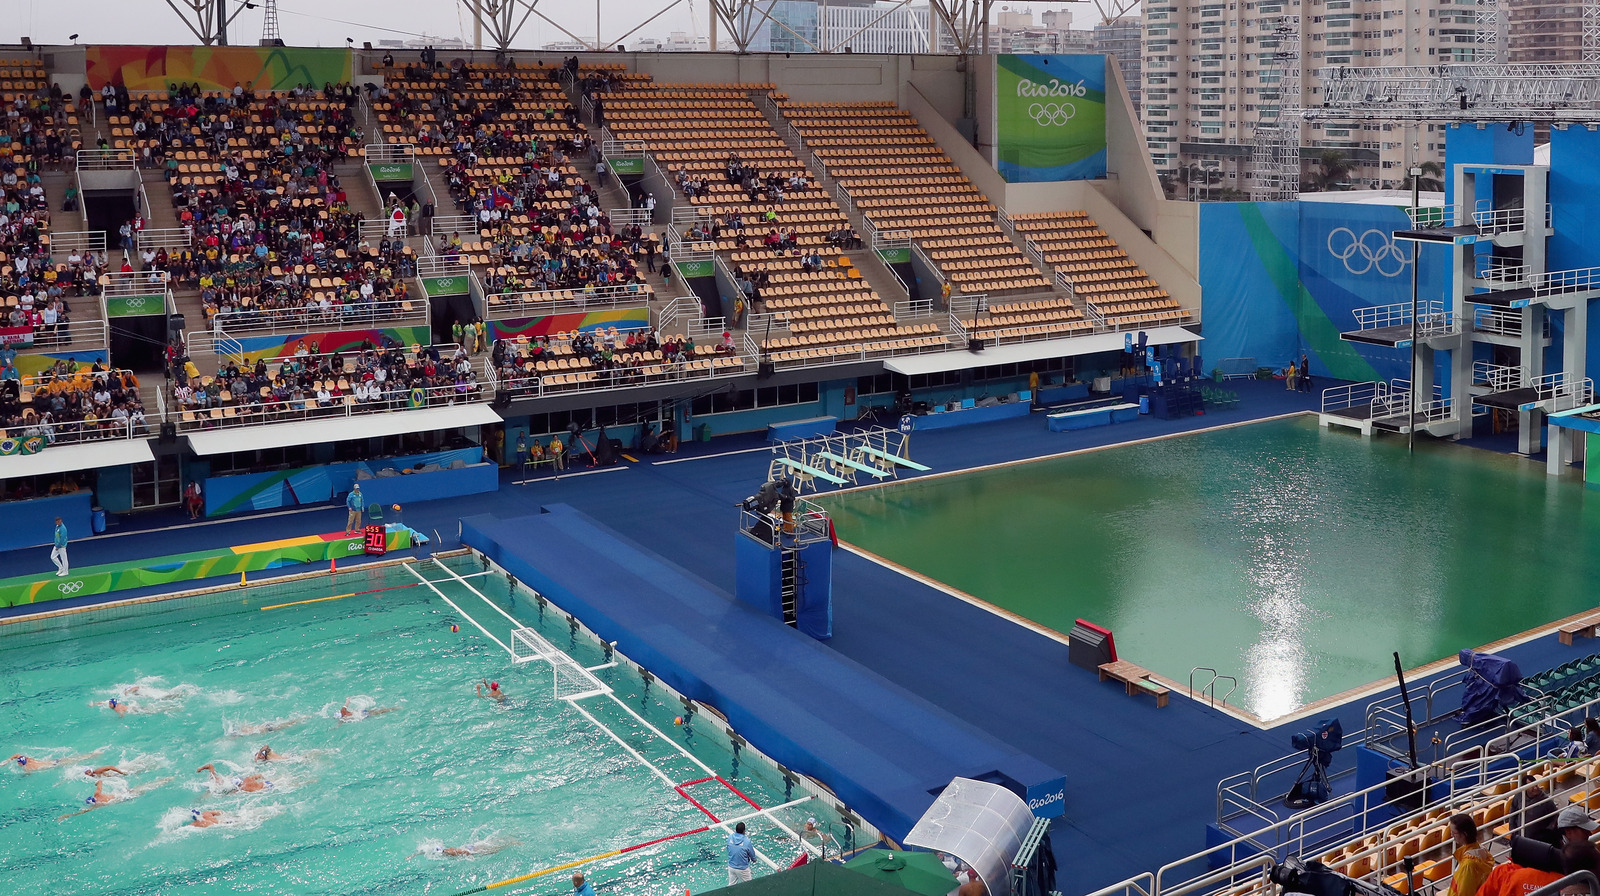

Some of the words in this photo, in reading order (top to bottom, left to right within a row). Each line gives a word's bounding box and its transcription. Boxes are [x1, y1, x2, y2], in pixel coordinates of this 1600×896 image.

[1017, 78, 1086, 97] Rio2016
[365, 532, 384, 547] 30
[1028, 788, 1064, 810] Rio2016
